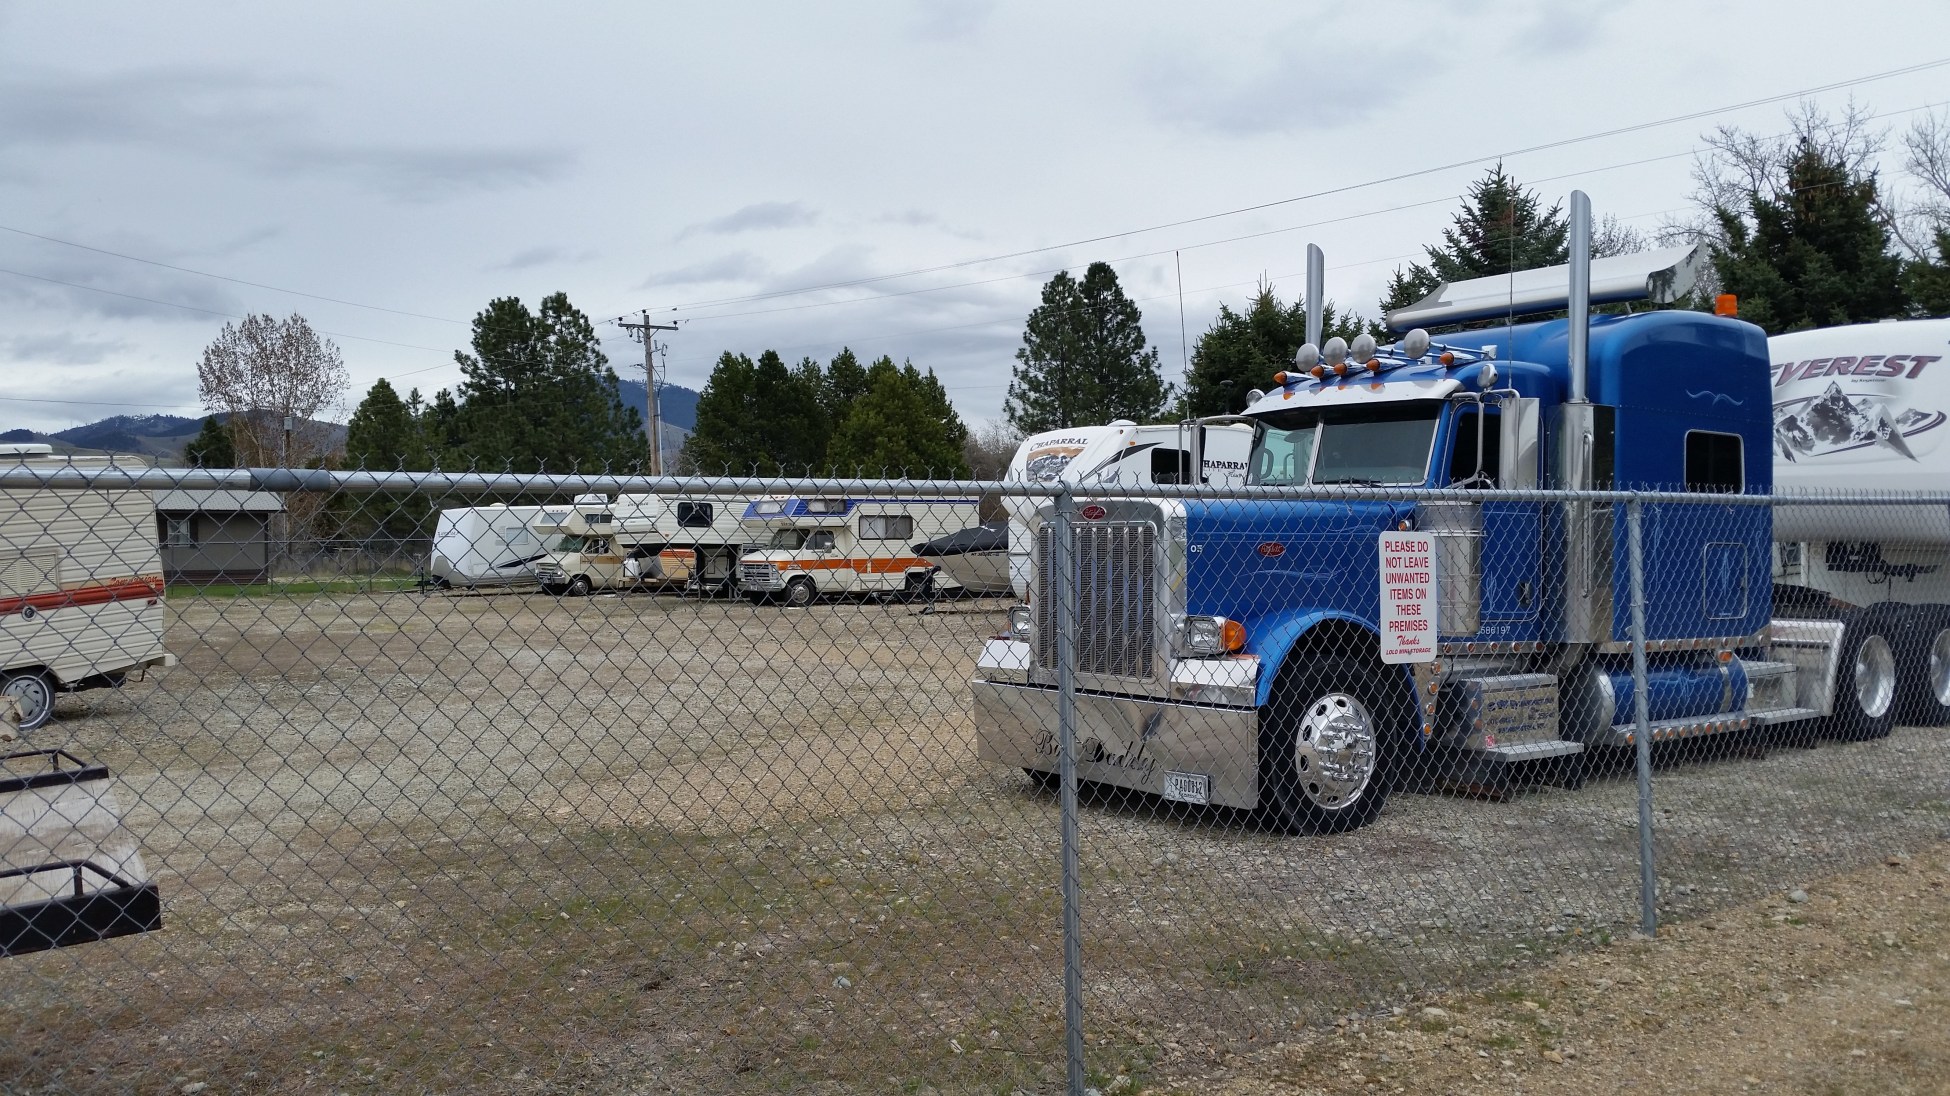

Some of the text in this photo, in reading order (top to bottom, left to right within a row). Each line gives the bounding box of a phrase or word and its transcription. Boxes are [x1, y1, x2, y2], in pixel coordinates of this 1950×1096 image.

[1030, 438, 1088, 451] CHAPARRAL
[1203, 460, 1247, 470] HAPARRA
[1385, 541, 1429, 553] PLEASE DO
[1385, 557, 1429, 568] NOT LEAVE
[1386, 572, 1430, 584] UNWANTED
[1390, 588, 1427, 600] ITEMS ON
[1396, 604, 1421, 616] THESE
[1389, 620, 1428, 632] PREMISES
[1397, 635, 1420, 647] Thanks
[1083, 737, 1156, 785] Daddy
